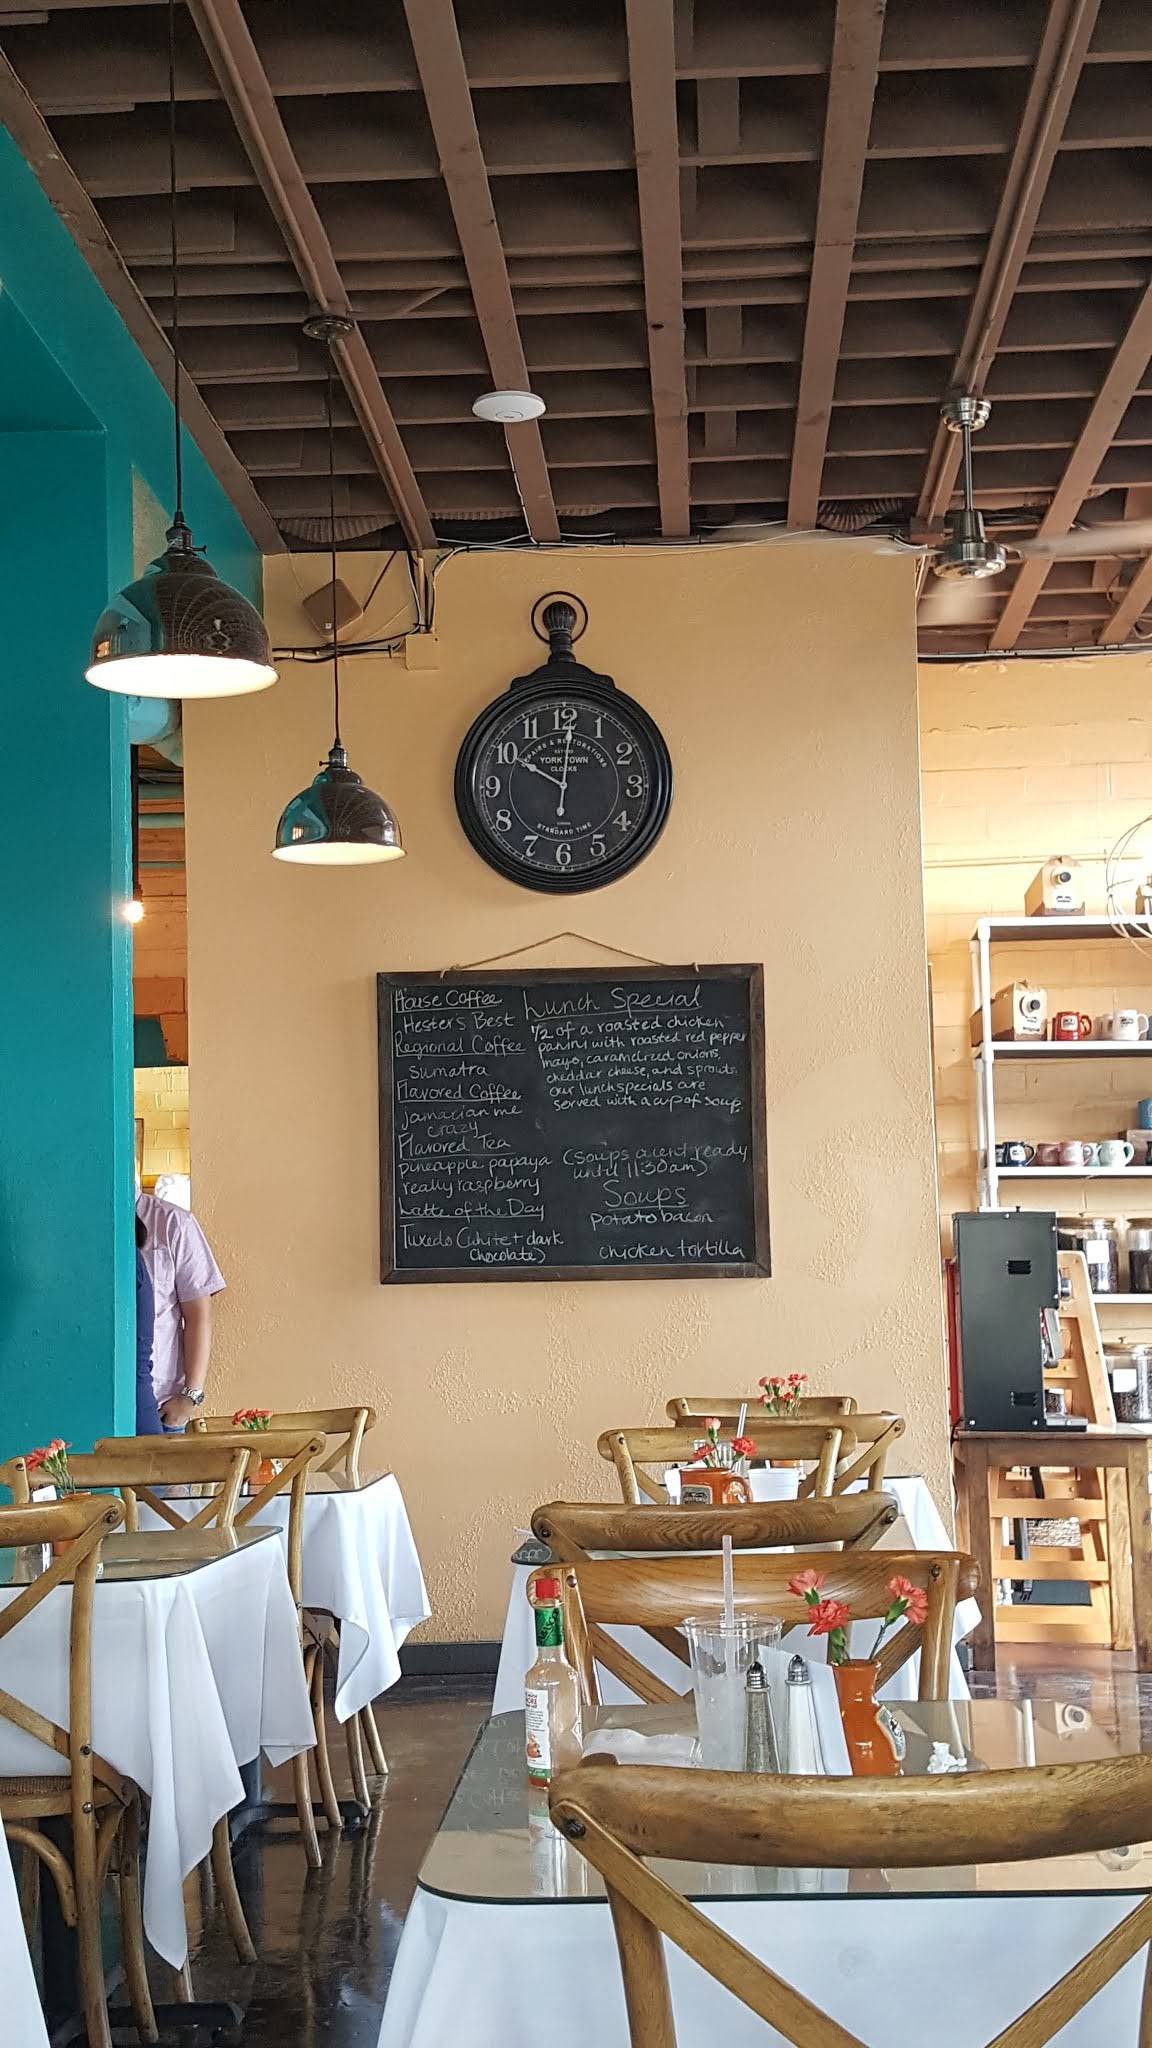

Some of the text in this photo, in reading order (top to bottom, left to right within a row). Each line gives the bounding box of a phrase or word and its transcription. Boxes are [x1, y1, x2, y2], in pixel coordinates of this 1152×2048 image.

[522, 717, 539, 739] 11
[552, 708, 577, 730] 12
[595, 717, 603, 739] 1
[496, 742, 518, 764] 10
[616, 742, 633, 765] 2
[485, 776, 500, 797] 9
[626, 775, 643, 797] 3
[496, 809, 512, 831] 8
[537, 822, 591, 835] STANDARD TIME
[613, 810, 631, 831] 4
[523, 836, 539, 857] 7
[556, 843, 571, 865] 6
[590, 834, 606, 856] 5
[395, 989, 502, 1012] House Coffee
[523, 984, 702, 1020] Lunch Special
[472, 1011, 515, 1030] Best
[556, 1021, 576, 1040] of
[580, 1026, 593, 1036] a
[597, 1014, 662, 1033] roasted
[667, 1013, 725, 1029] chicken
[395, 1030, 526, 1060] Regional Coffee
[538, 1030, 748, 1057] panini with roasted red pepper
[546, 1068, 602, 1084] cheddar
[652, 1063, 683, 1075] and
[397, 1079, 522, 1104] Flavored Coffee
[617, 1080, 673, 1095] specials
[678, 1080, 706, 1091] are
[494, 1106, 523, 1116] me
[553, 1095, 601, 1112] served
[607, 1094, 637, 1107] with
[640, 1097, 651, 1107] a
[653, 1095, 683, 1113] cup
[684, 1093, 702, 1109] of
[427, 1121, 480, 1138] crazy
[398, 1132, 512, 1159] Flavored Tea
[690, 1140, 748, 1163] ready
[398, 1155, 552, 1179] pineapple papaya
[573, 1160, 619, 1179] until
[402, 1177, 540, 1198] really raspberry
[602, 1179, 687, 1209] Soups
[398, 1197, 545, 1223] Latte of the Day
[590, 1209, 714, 1231] potato bacon
[400, 1223, 453, 1249] Tuxedo
[526, 1230, 564, 1246] dark
[600, 1239, 747, 1260] chicken tortilla
